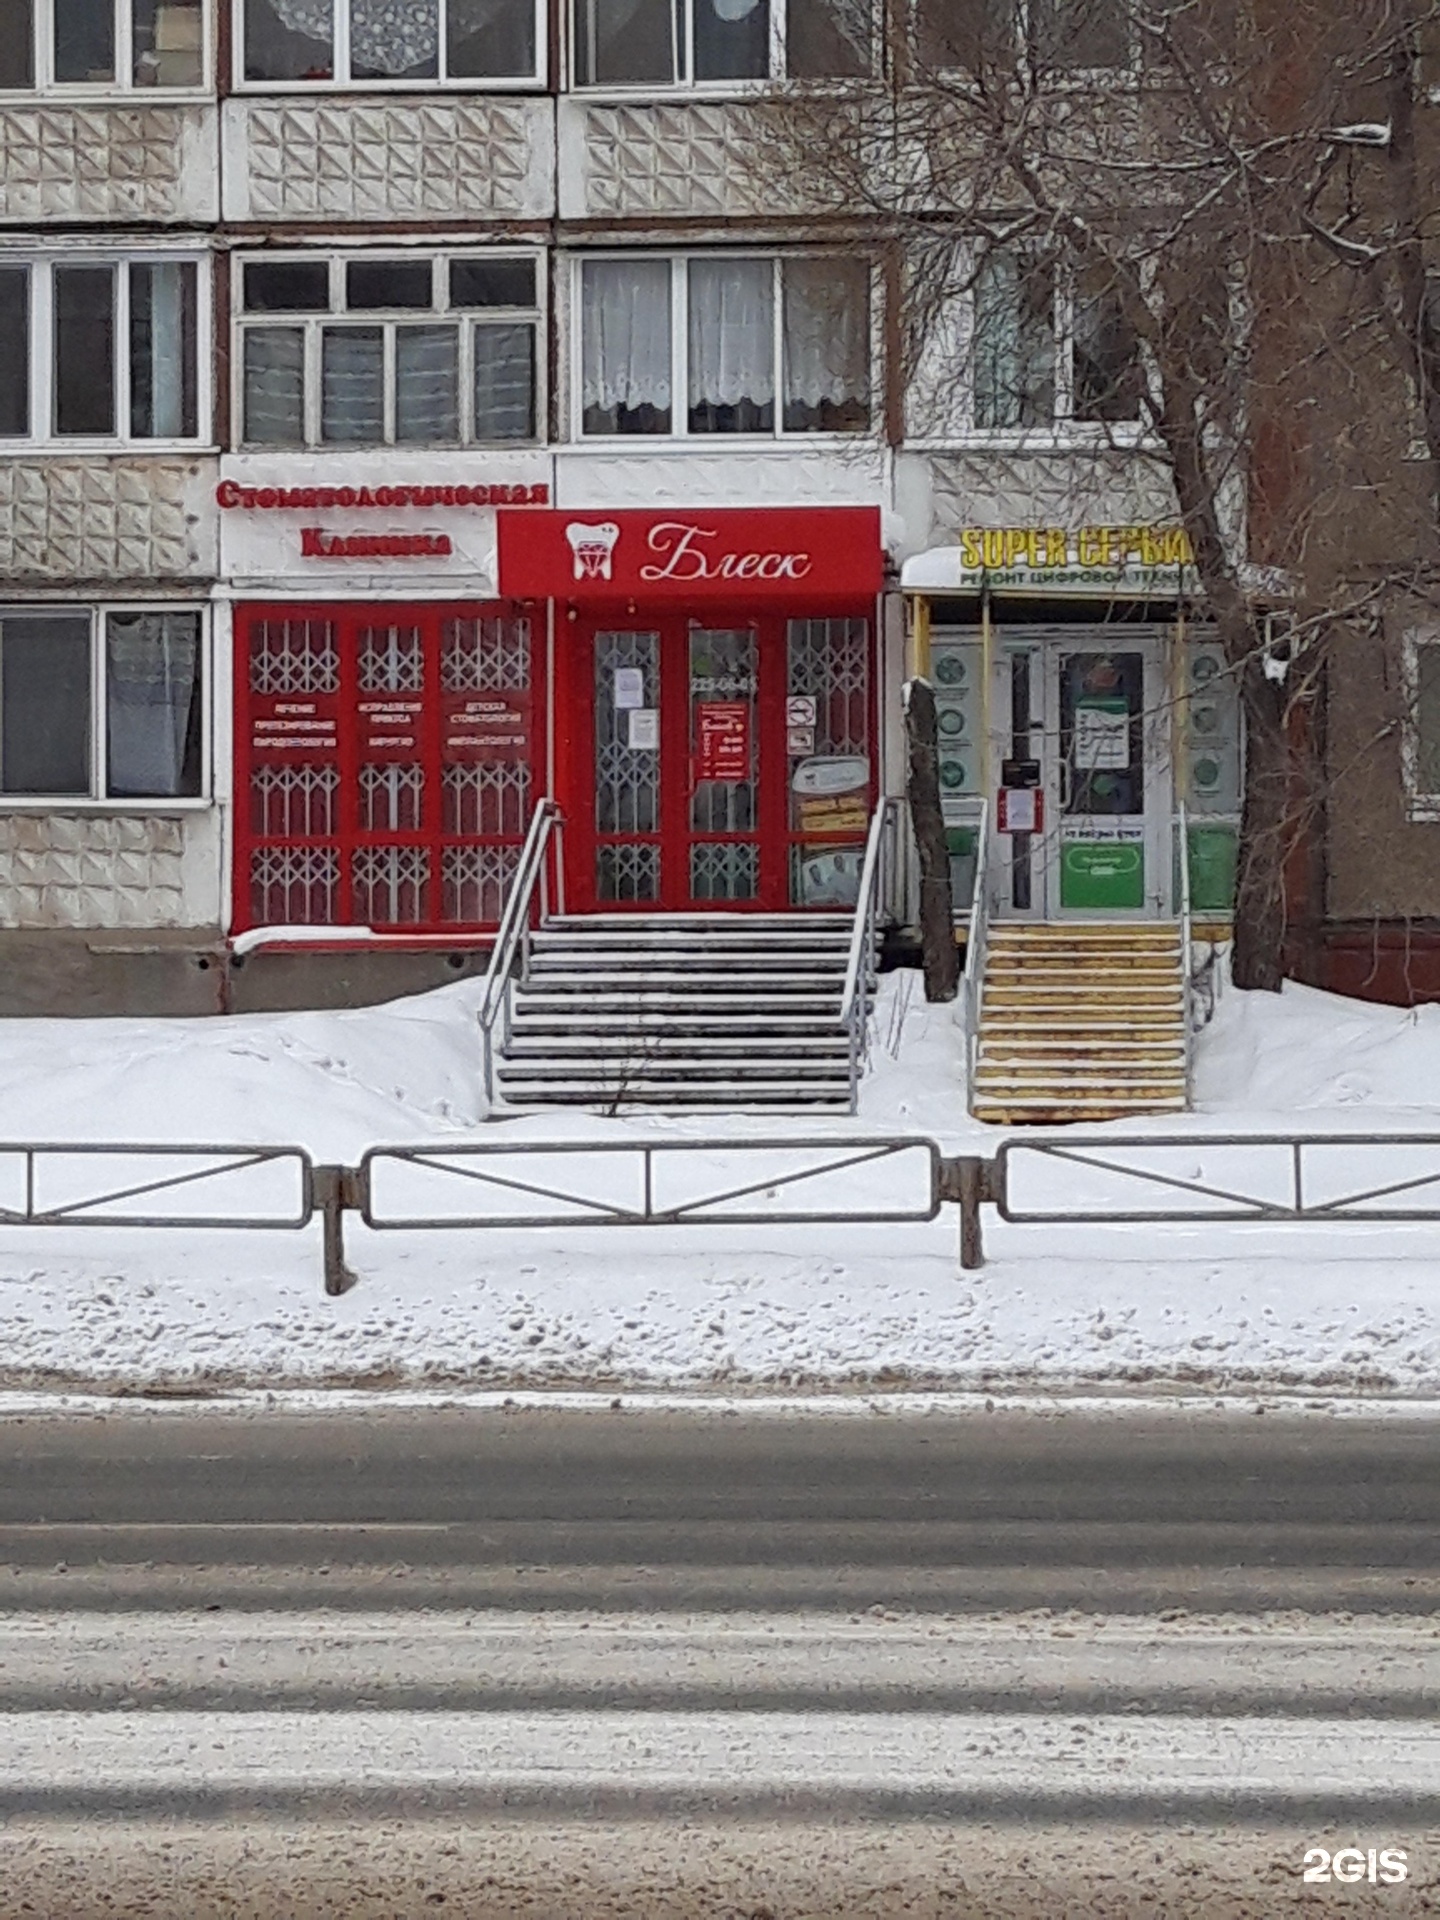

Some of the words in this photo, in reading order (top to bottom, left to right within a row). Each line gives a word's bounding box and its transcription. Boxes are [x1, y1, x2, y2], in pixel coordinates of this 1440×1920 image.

[216, 480, 548, 508] Стоматологическая
[300, 528, 452, 556] Клиника
[640, 522, 812, 580] Блеск
[961, 527, 1067, 568] SUPER
[1078, 526, 1194, 566] СЕРВИ
